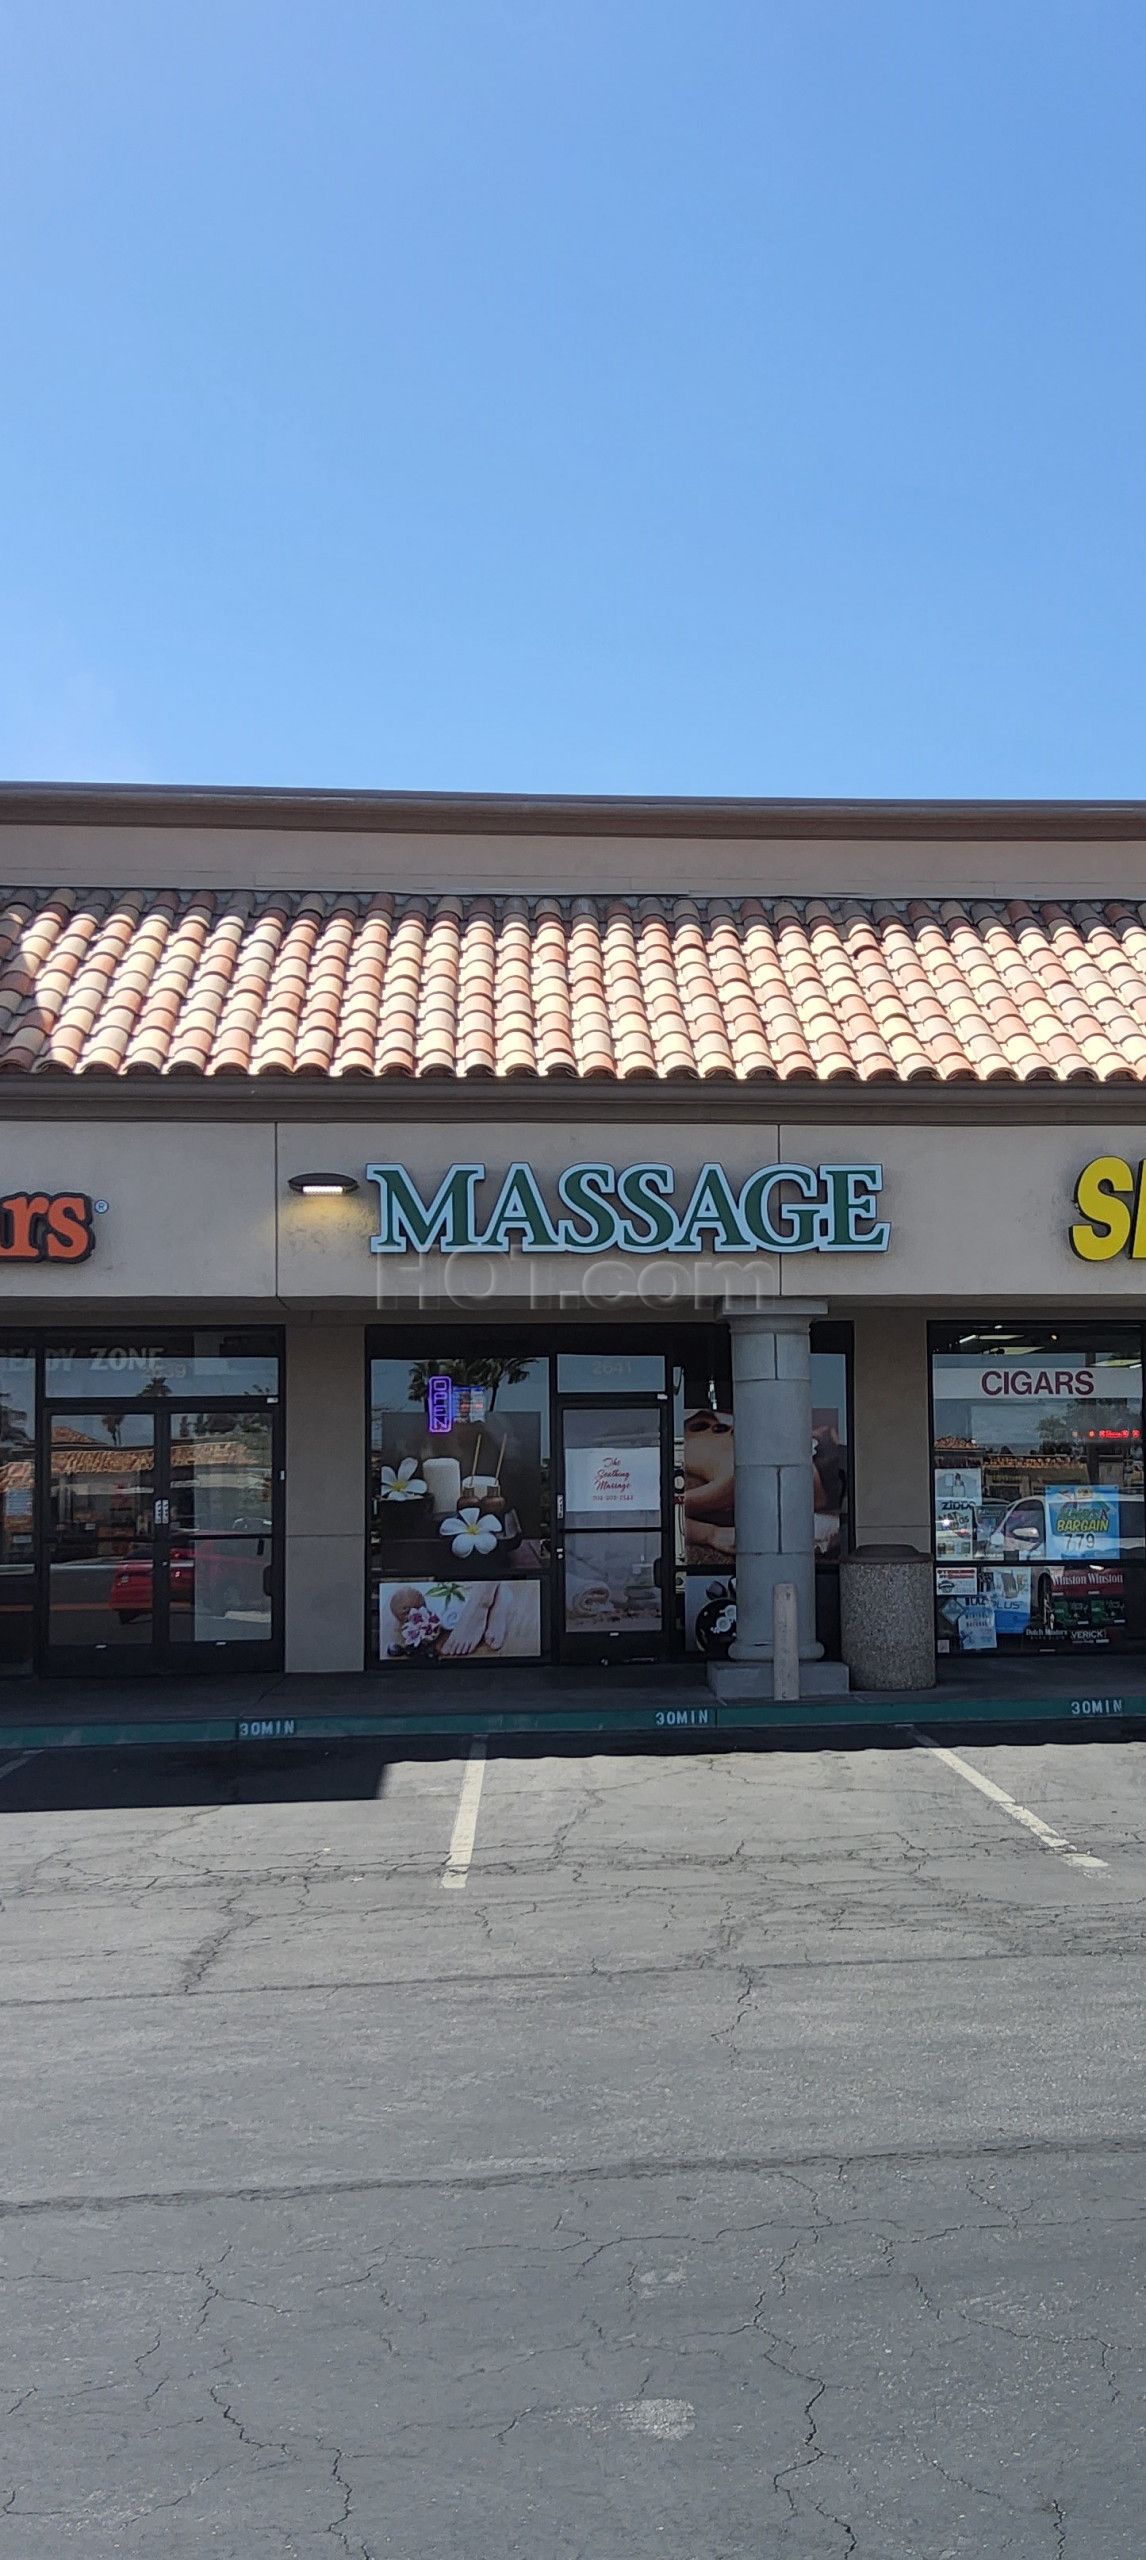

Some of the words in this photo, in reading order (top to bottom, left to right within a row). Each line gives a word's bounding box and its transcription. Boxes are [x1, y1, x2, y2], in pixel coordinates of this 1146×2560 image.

[0, 1192, 94, 1262] rs
[366, 1162, 892, 1254] MASSAGE
[1069, 1156, 1146, 1261] S
[89, 1347, 165, 1371] ZONE
[981, 1370, 1095, 1396] CIGARS
[432, 1379, 449, 1429] OPEN
[1056, 1520, 1109, 1532] BARGAIN
[1051, 1574, 1087, 1586] Winston
[1087, 1572, 1124, 1584] Winston
